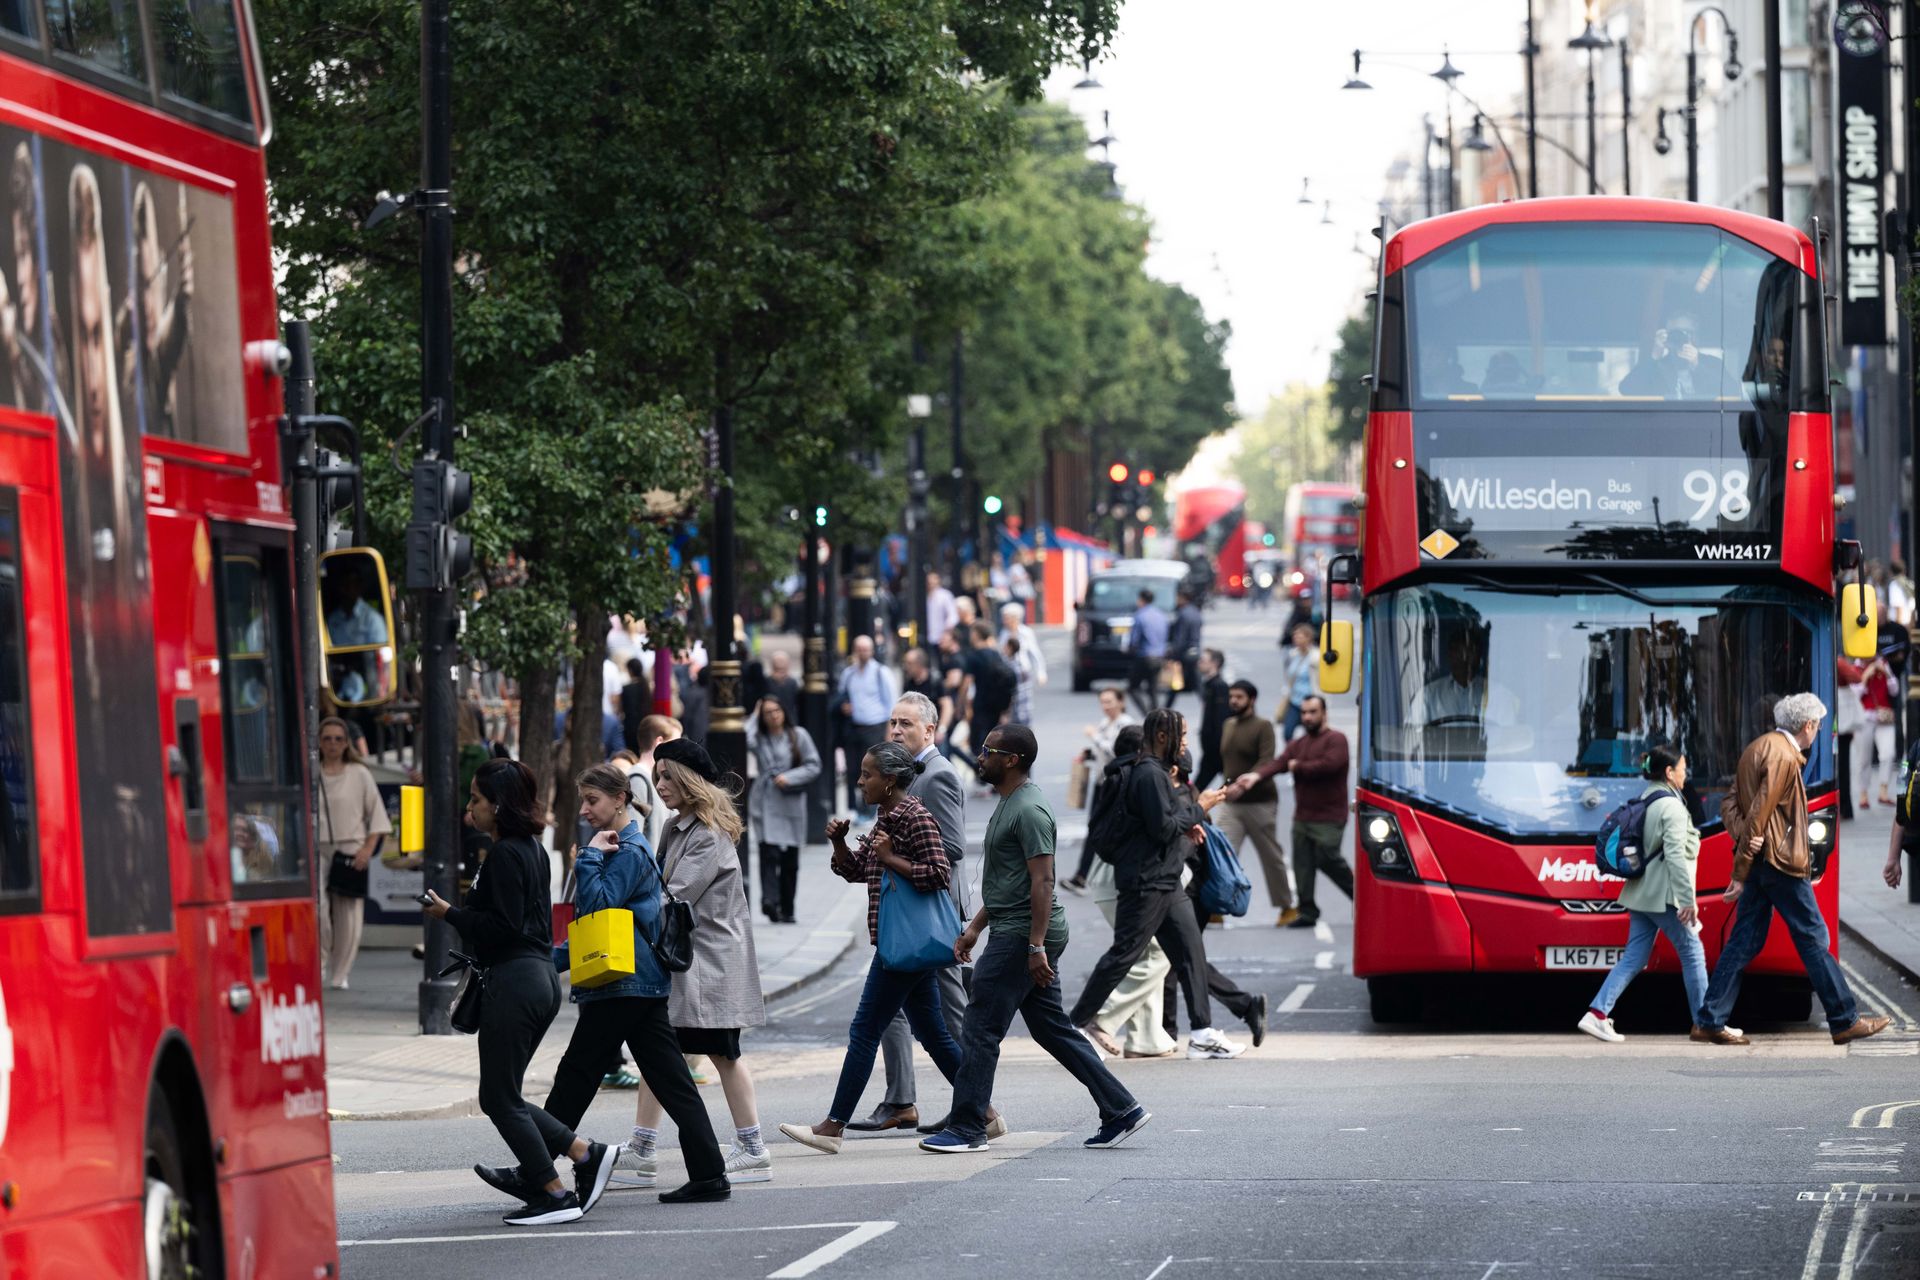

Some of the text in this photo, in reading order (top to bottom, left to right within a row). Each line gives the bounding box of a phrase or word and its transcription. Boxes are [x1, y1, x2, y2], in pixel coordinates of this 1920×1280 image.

[1845, 105, 1880, 302] THE HMV SHOP
[1443, 477, 1592, 510] Willesden
[1607, 478, 1632, 493] Bus
[1682, 469, 1751, 522] 98
[1597, 496, 1643, 515] Garage
[1694, 544, 1772, 560] VWH2417
[1553, 949, 1600, 966] LK67
